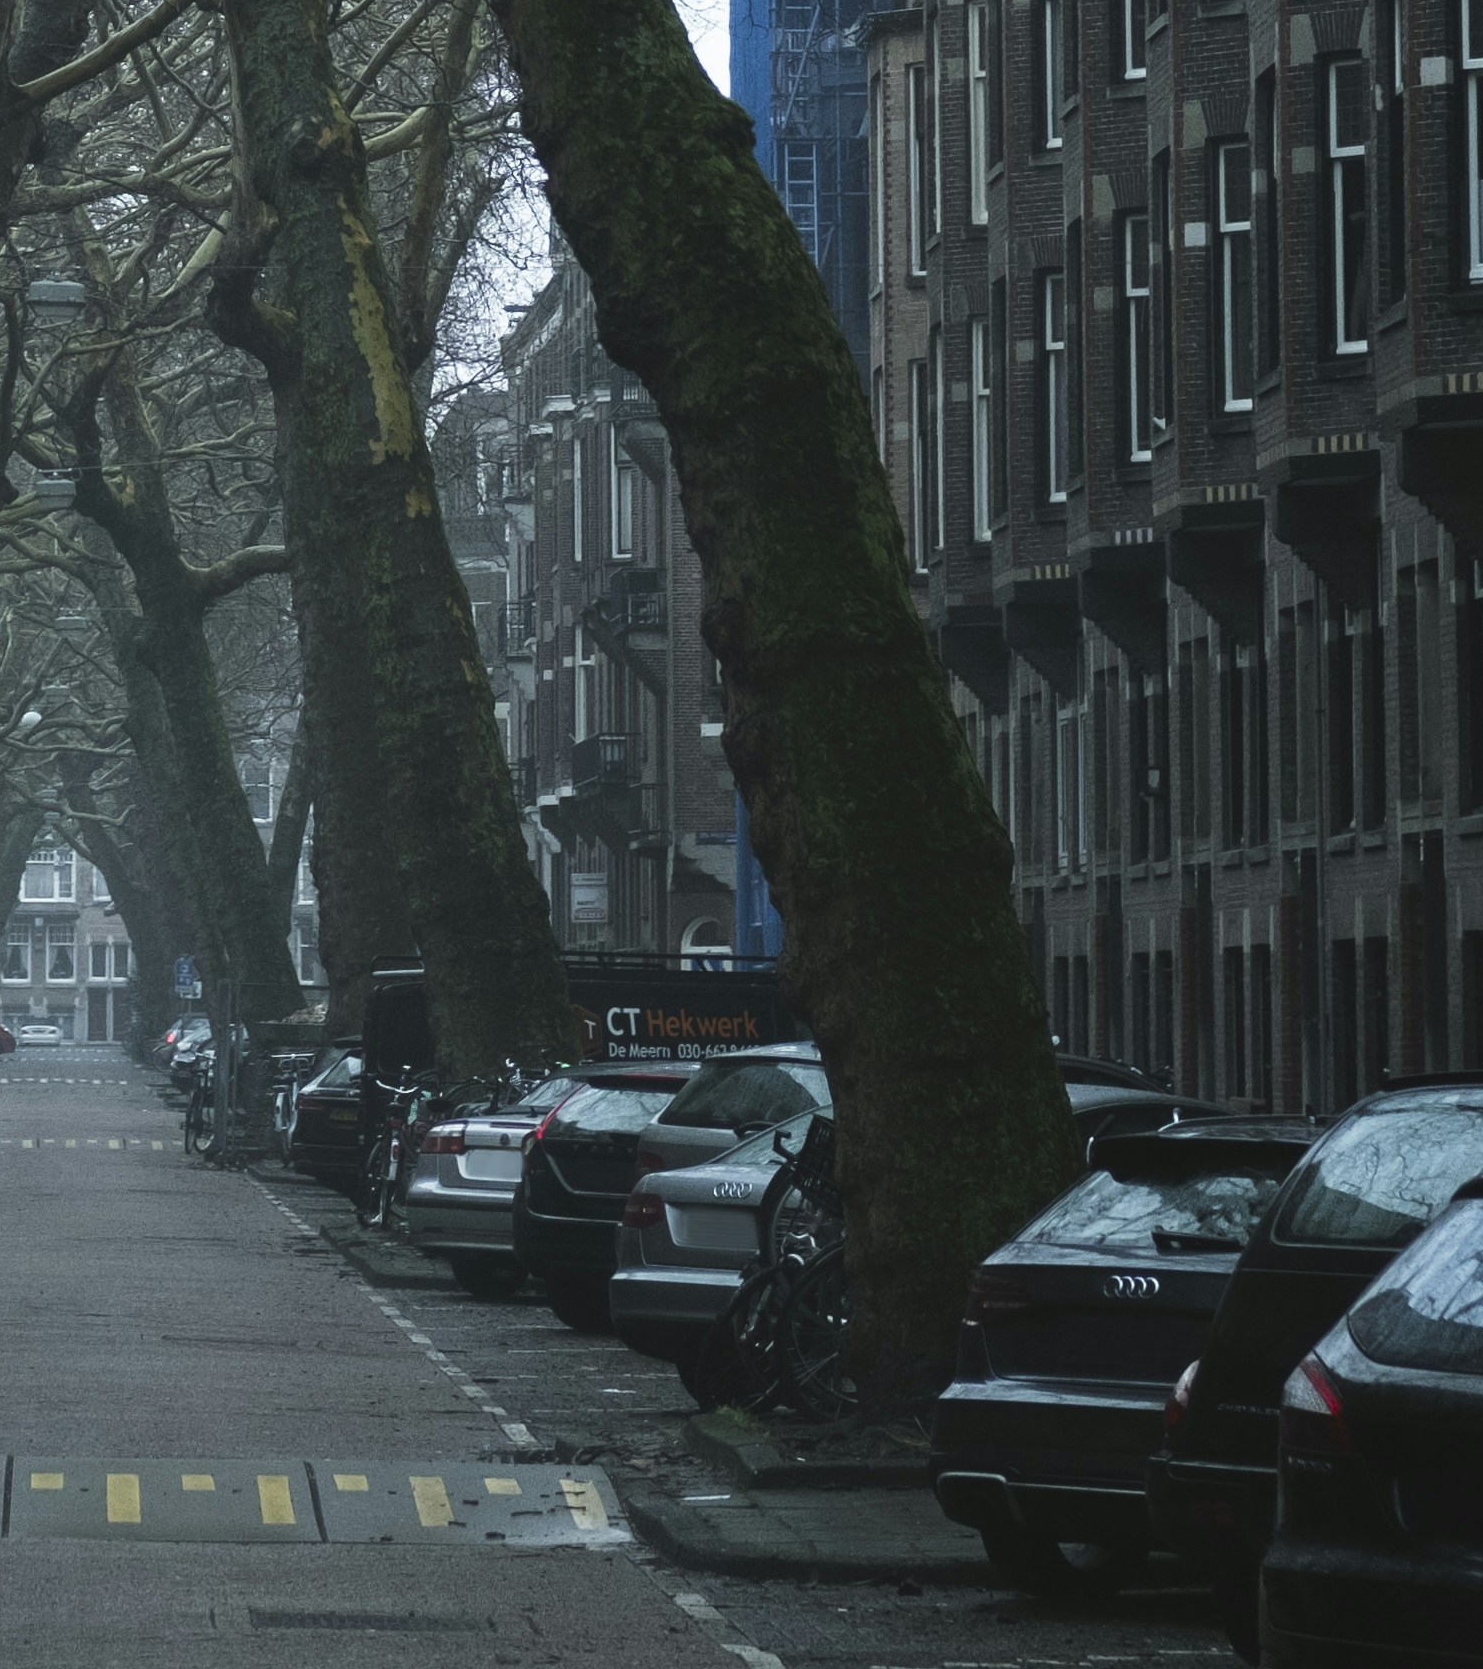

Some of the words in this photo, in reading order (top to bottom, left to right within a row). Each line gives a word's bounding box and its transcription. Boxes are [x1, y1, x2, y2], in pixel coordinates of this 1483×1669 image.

[606, 1006, 642, 1036] CT
[646, 1008, 760, 1039] Hekwerk
[608, 1041, 627, 1058] De
[629, 1042, 671, 1059] Meern
